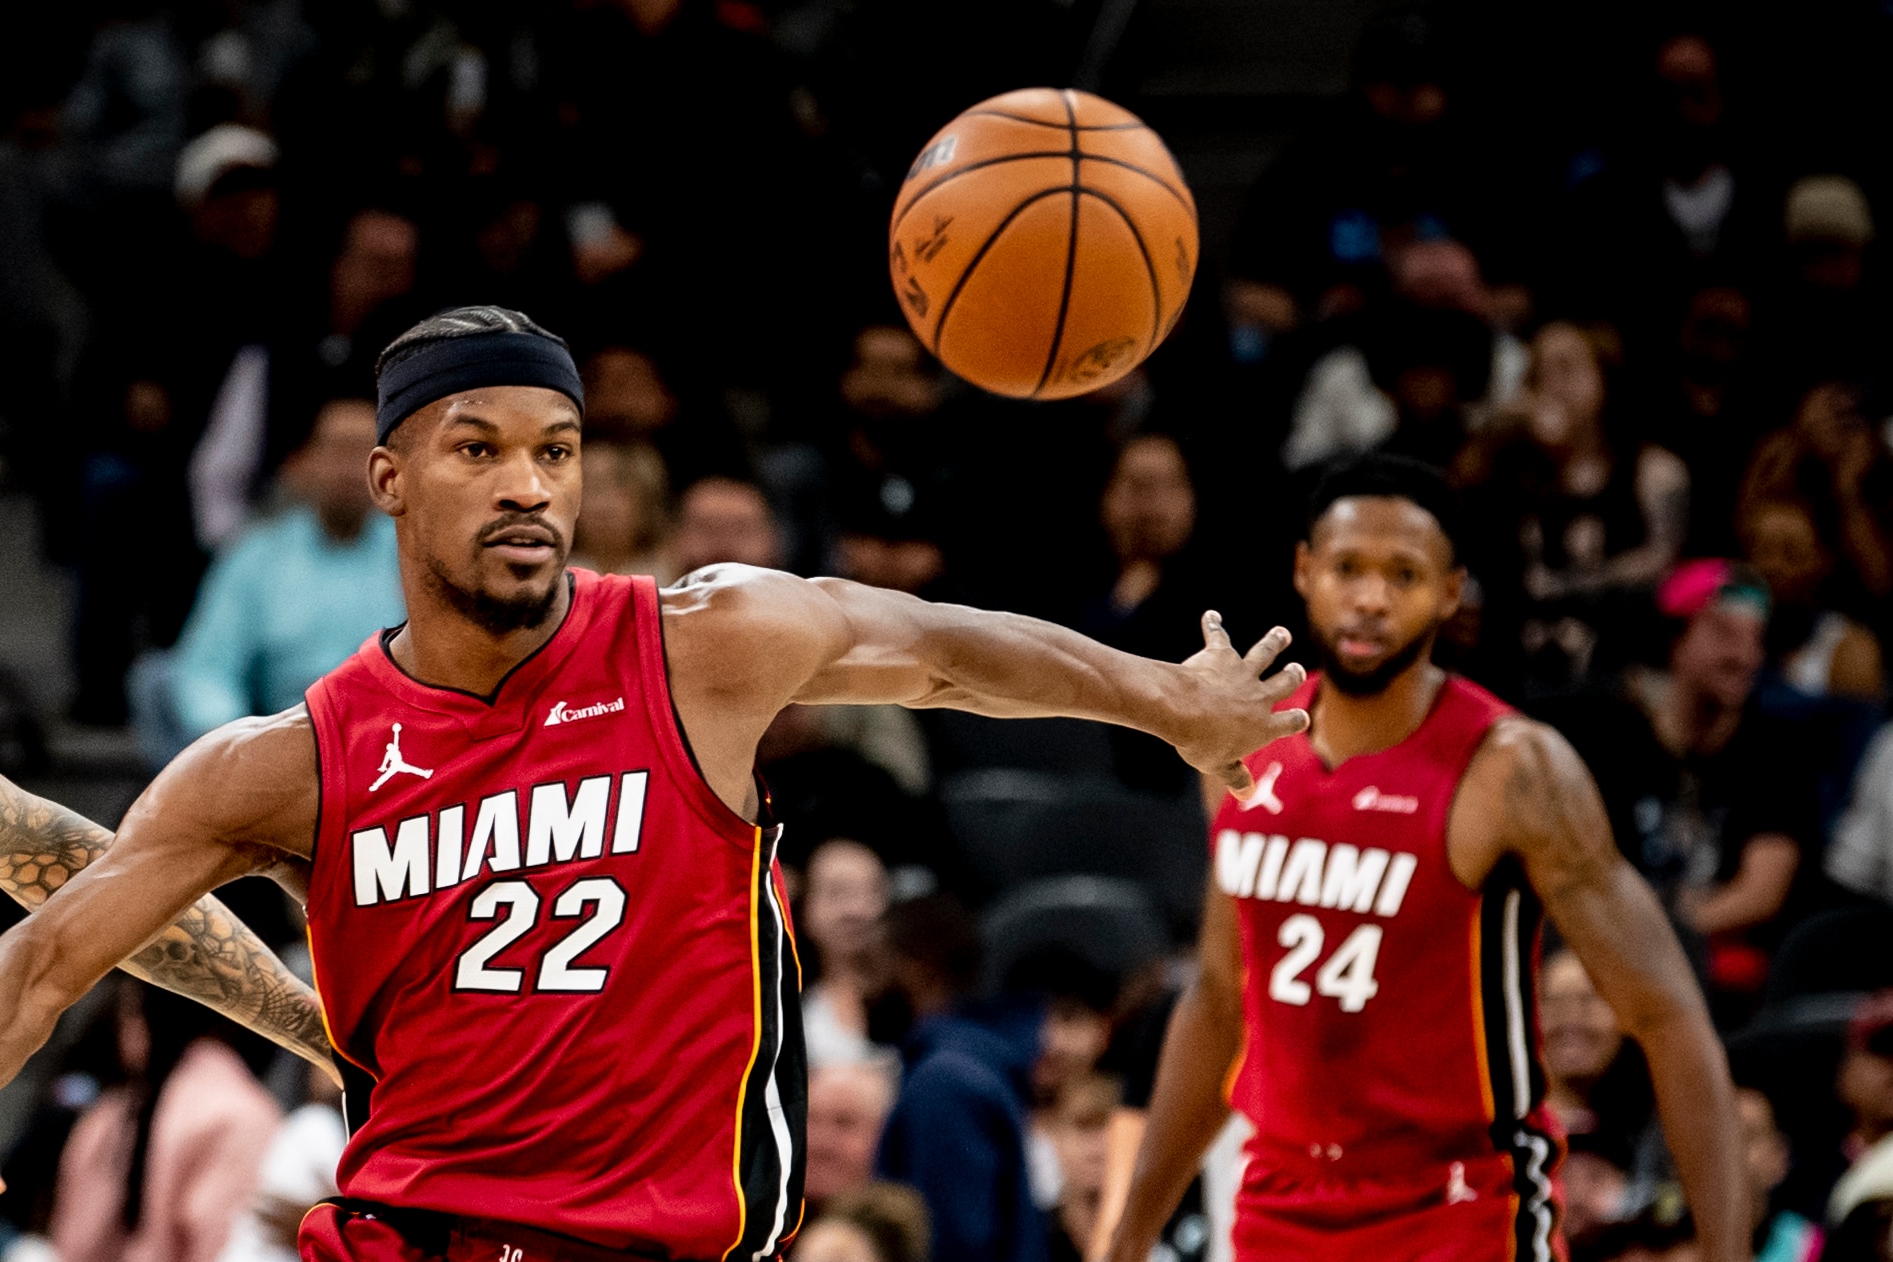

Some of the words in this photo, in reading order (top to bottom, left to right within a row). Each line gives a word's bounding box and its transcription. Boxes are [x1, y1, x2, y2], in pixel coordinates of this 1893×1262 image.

[561, 697, 625, 723] Carnival
[351, 769, 649, 907] MIAMI
[1216, 829, 1417, 918] MIAMI
[452, 876, 626, 995] 22
[1268, 914, 1383, 1013] 24
